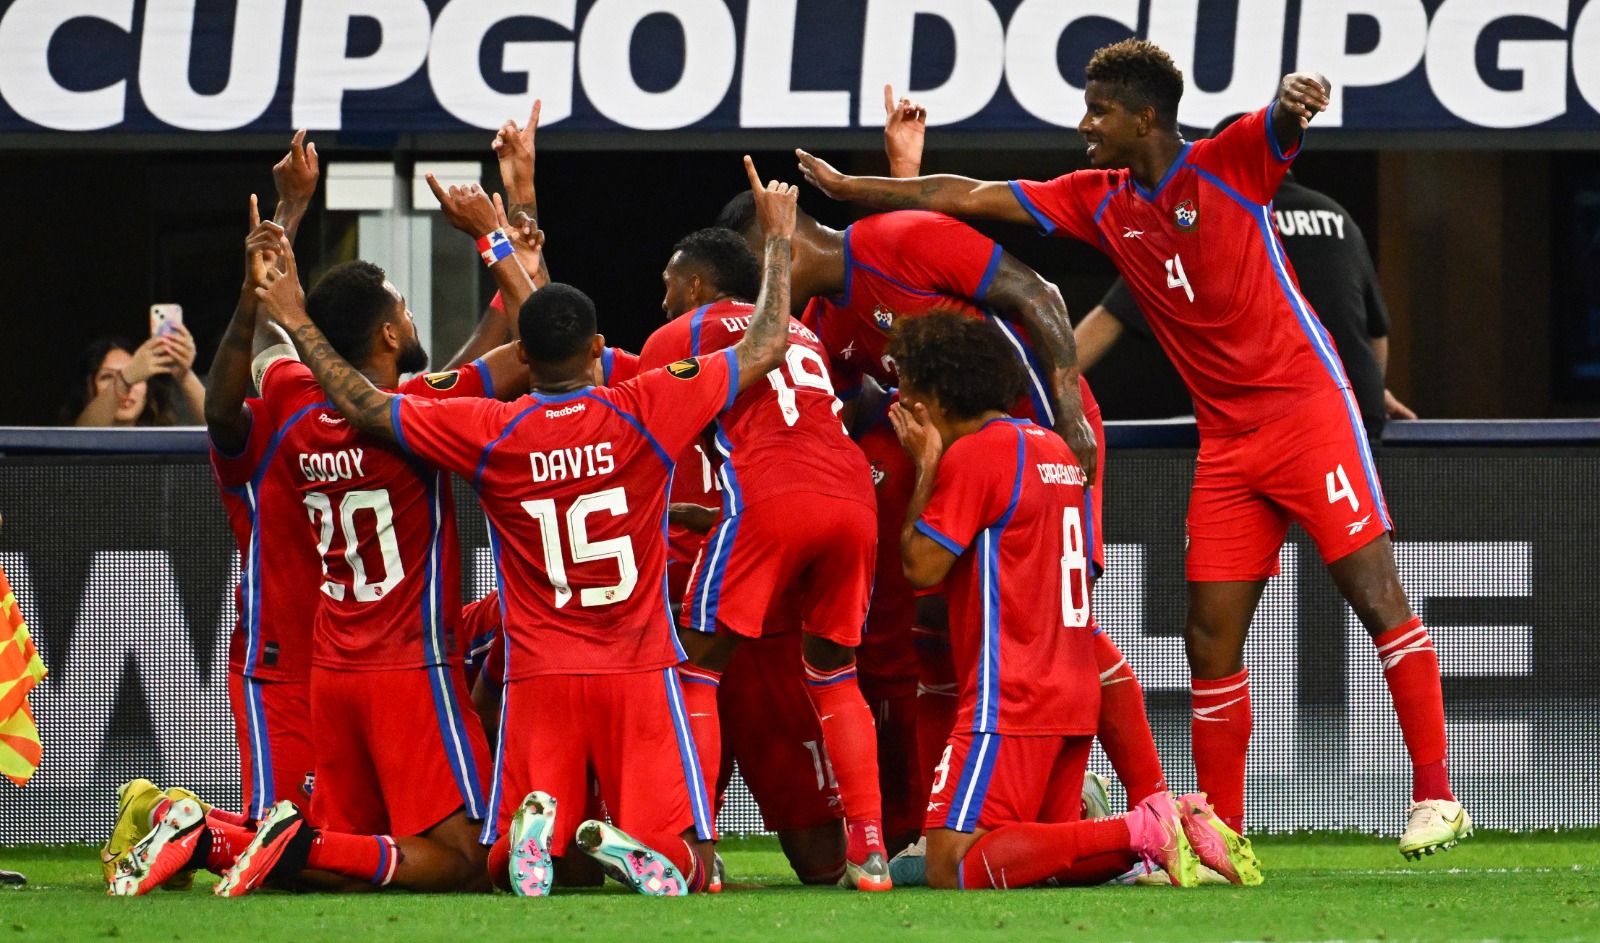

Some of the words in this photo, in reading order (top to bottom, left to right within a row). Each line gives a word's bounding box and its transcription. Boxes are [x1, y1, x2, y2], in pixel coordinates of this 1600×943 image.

[1275, 209, 1345, 240] URITY
[1165, 254, 1195, 303] 4
[545, 402, 586, 419] Reebok
[298, 447, 365, 482] GODOY
[529, 442, 615, 483] DAVIS
[1325, 463, 1360, 513] 4
[303, 488, 405, 602] 20
[521, 486, 639, 609] 15
[1060, 507, 1090, 628] 8
